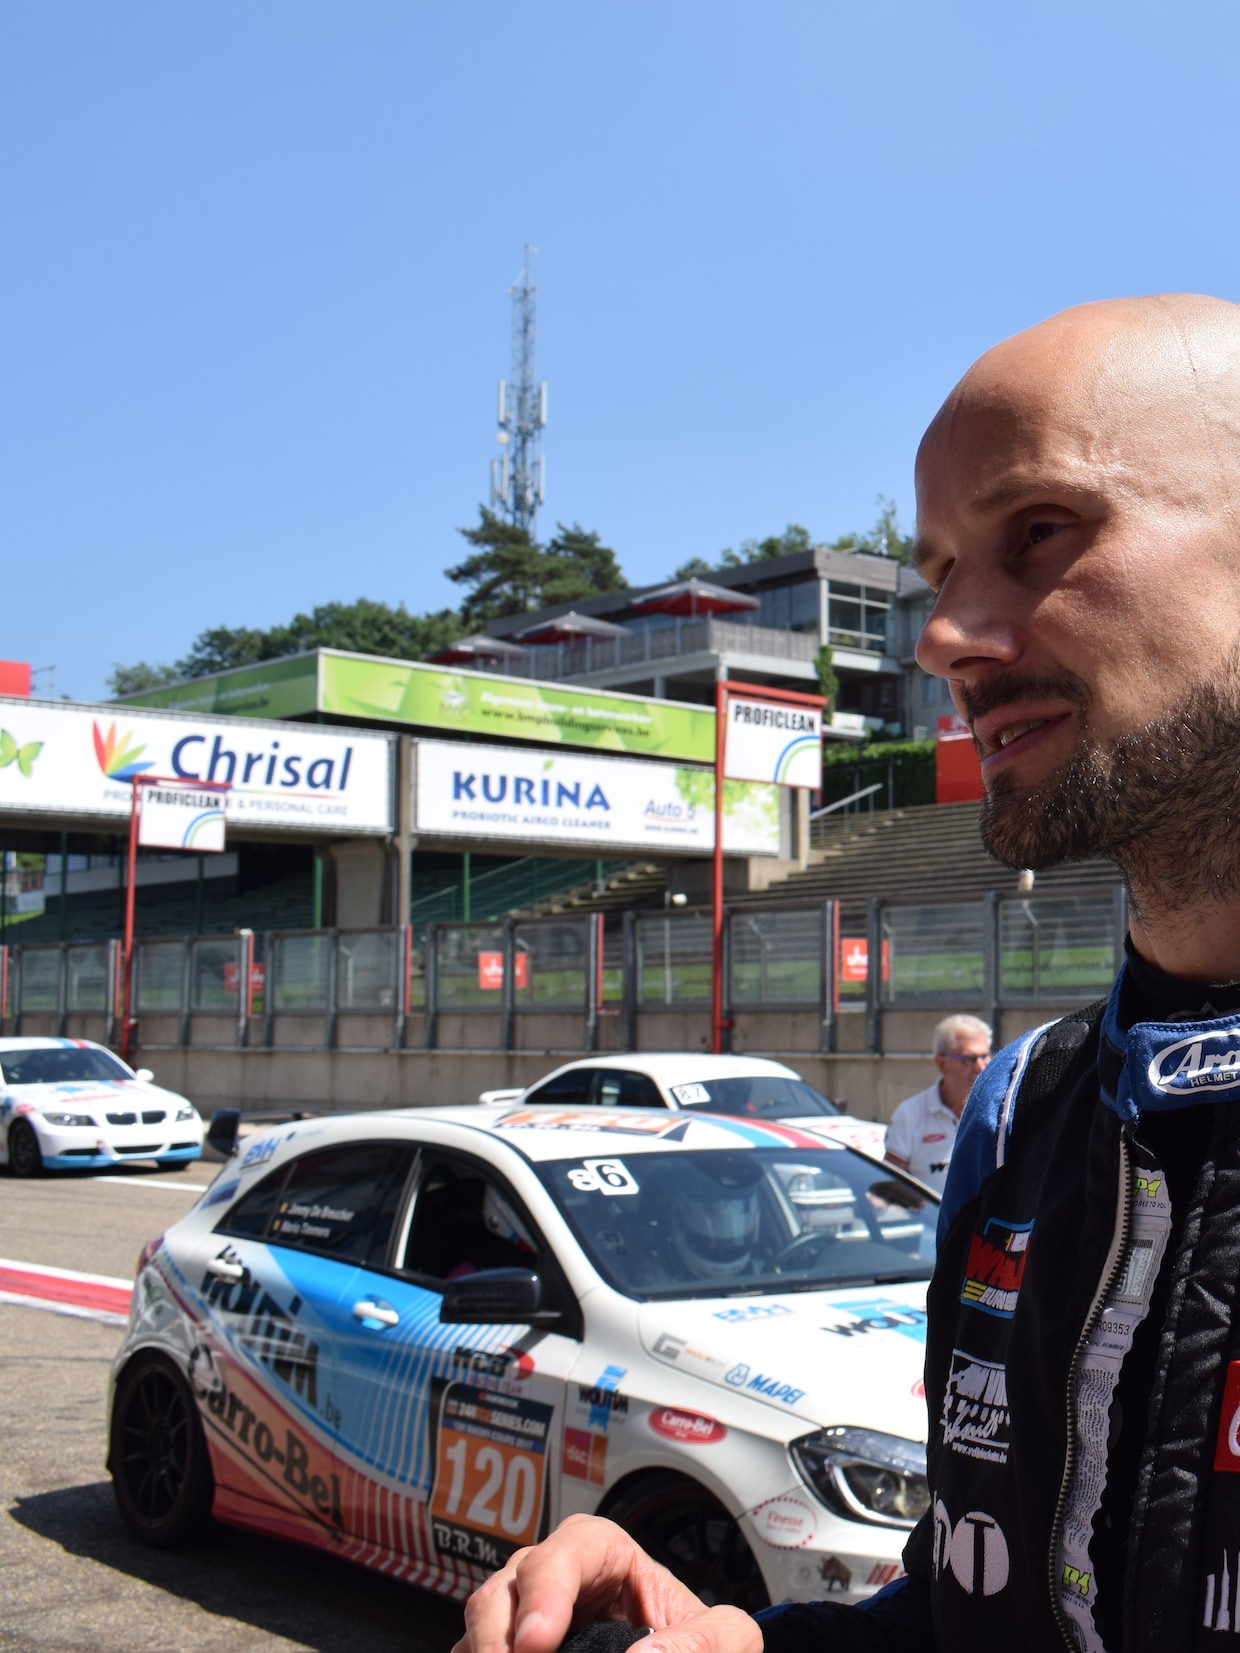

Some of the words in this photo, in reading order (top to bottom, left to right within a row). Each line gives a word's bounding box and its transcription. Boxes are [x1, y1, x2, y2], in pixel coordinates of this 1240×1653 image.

[734, 705, 816, 732] PROFICLEAN
[171, 734, 354, 792] Chrisal
[453, 771, 611, 812] KURINA
[1190, 1071, 1238, 1087] HELMET
[747, 1374, 808, 1406] MAPEI
[660, 1409, 716, 1436] Carro-Bel
[445, 1437, 537, 1536] 120
